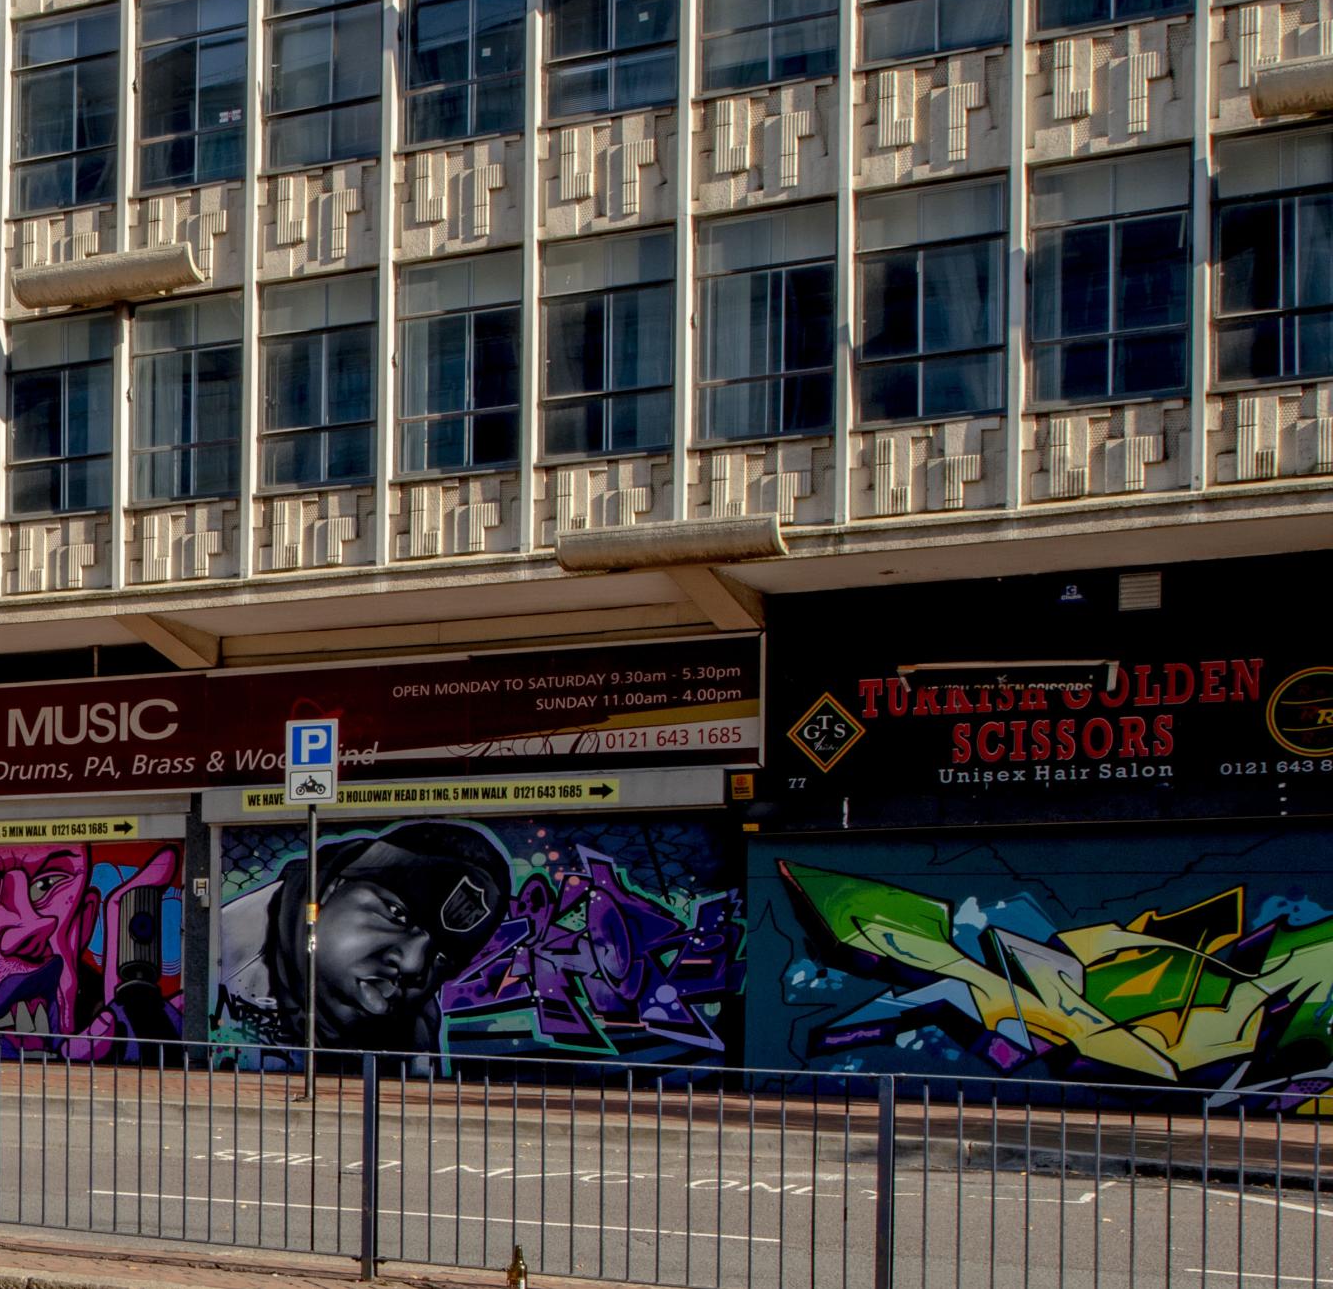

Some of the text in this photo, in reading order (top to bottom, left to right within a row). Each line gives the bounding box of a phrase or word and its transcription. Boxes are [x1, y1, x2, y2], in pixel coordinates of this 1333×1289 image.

[392, 684, 431, 698] OPEN
[435, 679, 500, 696] MONDAY
[504, 678, 524, 692] TO
[528, 672, 606, 691] SATURDAY
[610, 670, 667, 685] 9.30am
[682, 665, 741, 683] 5.30pm
[535, 696, 597, 711] SUNDAY
[603, 691, 668, 707] 11.00am
[682, 688, 742, 704] 4.00pm
[7, 698, 179, 747] MUSIC
[300, 728, 328, 763] P
[605, 726, 742, 749] 0121 643 1685
[952, 714, 1174, 764] SCISSORS
[84, 755, 121, 779] PA,
[132, 753, 195, 776] Brass
[205, 751, 225, 772] &
[235, 741, 380, 772] Wooind
[1219, 762, 1268, 775] 0121
[1276, 759, 1314, 773] 643
[788, 777, 807, 789] 77
[938, 763, 1174, 784] Unisex Hair Salon
[247, 793, 284, 807] WE HAVE
[346, 790, 392, 804] HOLLOWAY
[394, 788, 417, 802] HEAD
[419, 788, 430, 802] B1
[453, 787, 459, 800] 5
[461, 787, 480, 801] MIN
[481, 786, 508, 800] WALK
[513, 785, 535, 799] 0121
[536, 785, 556, 799] 643
[558, 784, 582, 798] 1685
[2, 826, 8, 837] 5
[9, 825, 24, 837] MIN
[25, 824, 47, 837] WALK
[51, 824, 70, 836] 0121
[71, 823, 87, 835] 643
[88, 822, 108, 835] 1685
